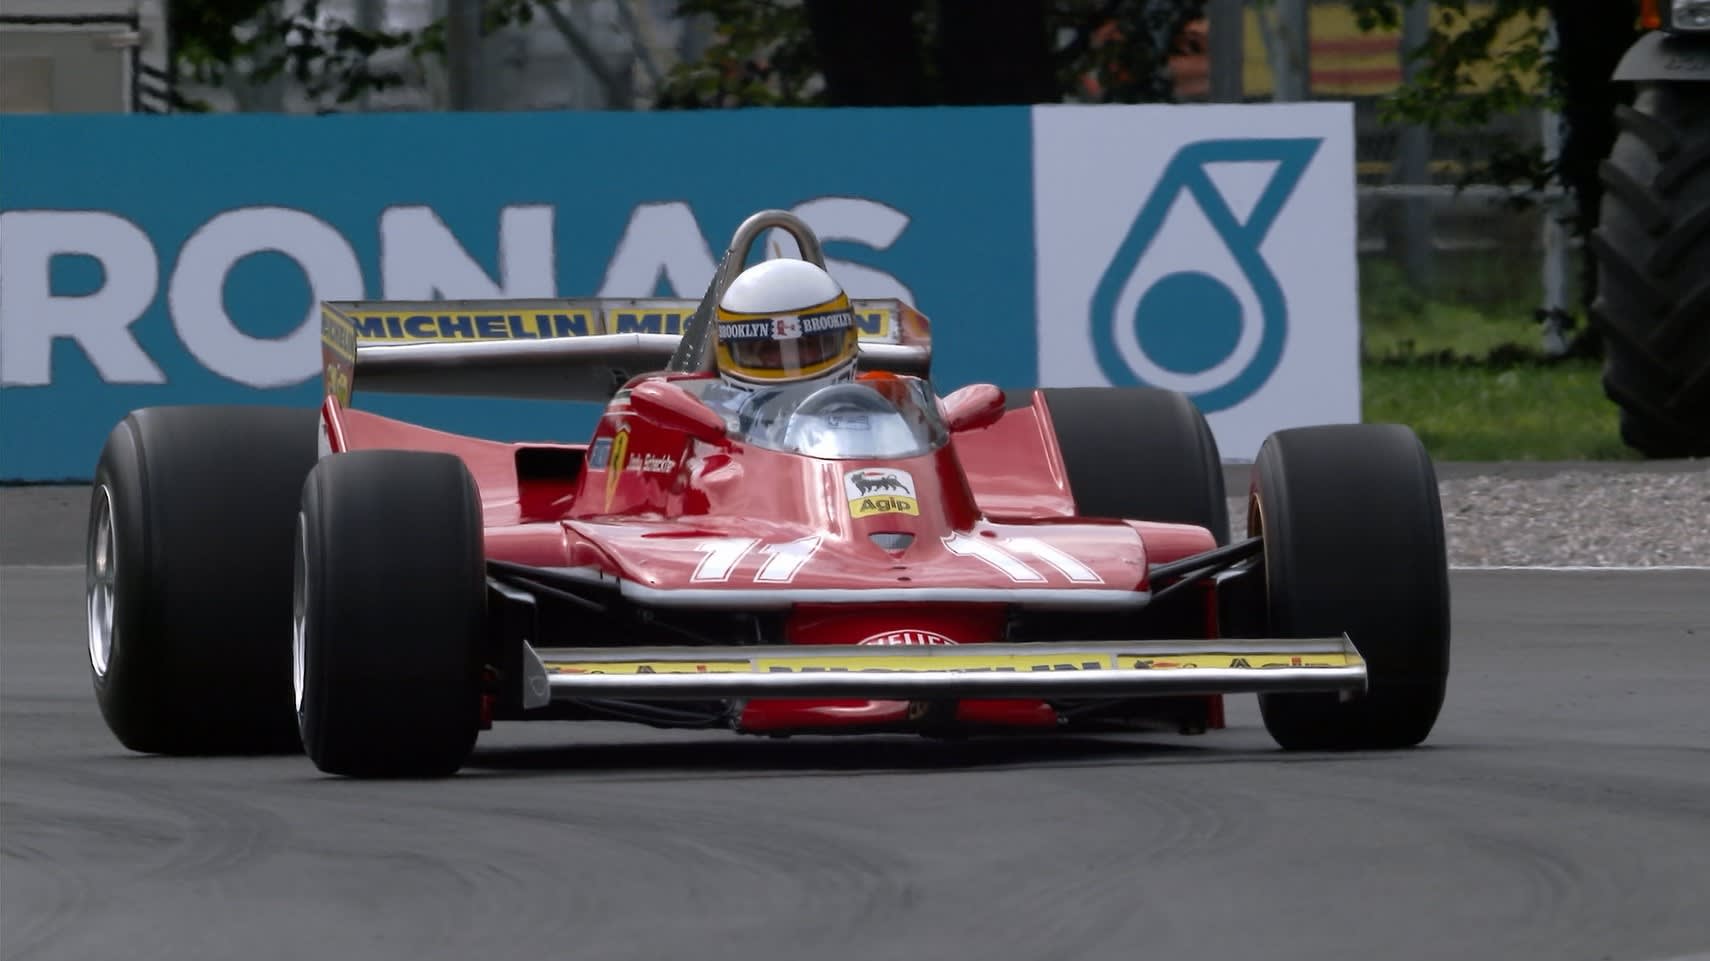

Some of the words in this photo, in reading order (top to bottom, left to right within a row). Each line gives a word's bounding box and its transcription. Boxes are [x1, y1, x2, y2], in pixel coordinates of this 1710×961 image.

[349, 314, 589, 338] MICHELIN
[859, 497, 911, 512] Agip
[690, 535, 823, 583] 11
[940, 531, 1105, 584] 11
